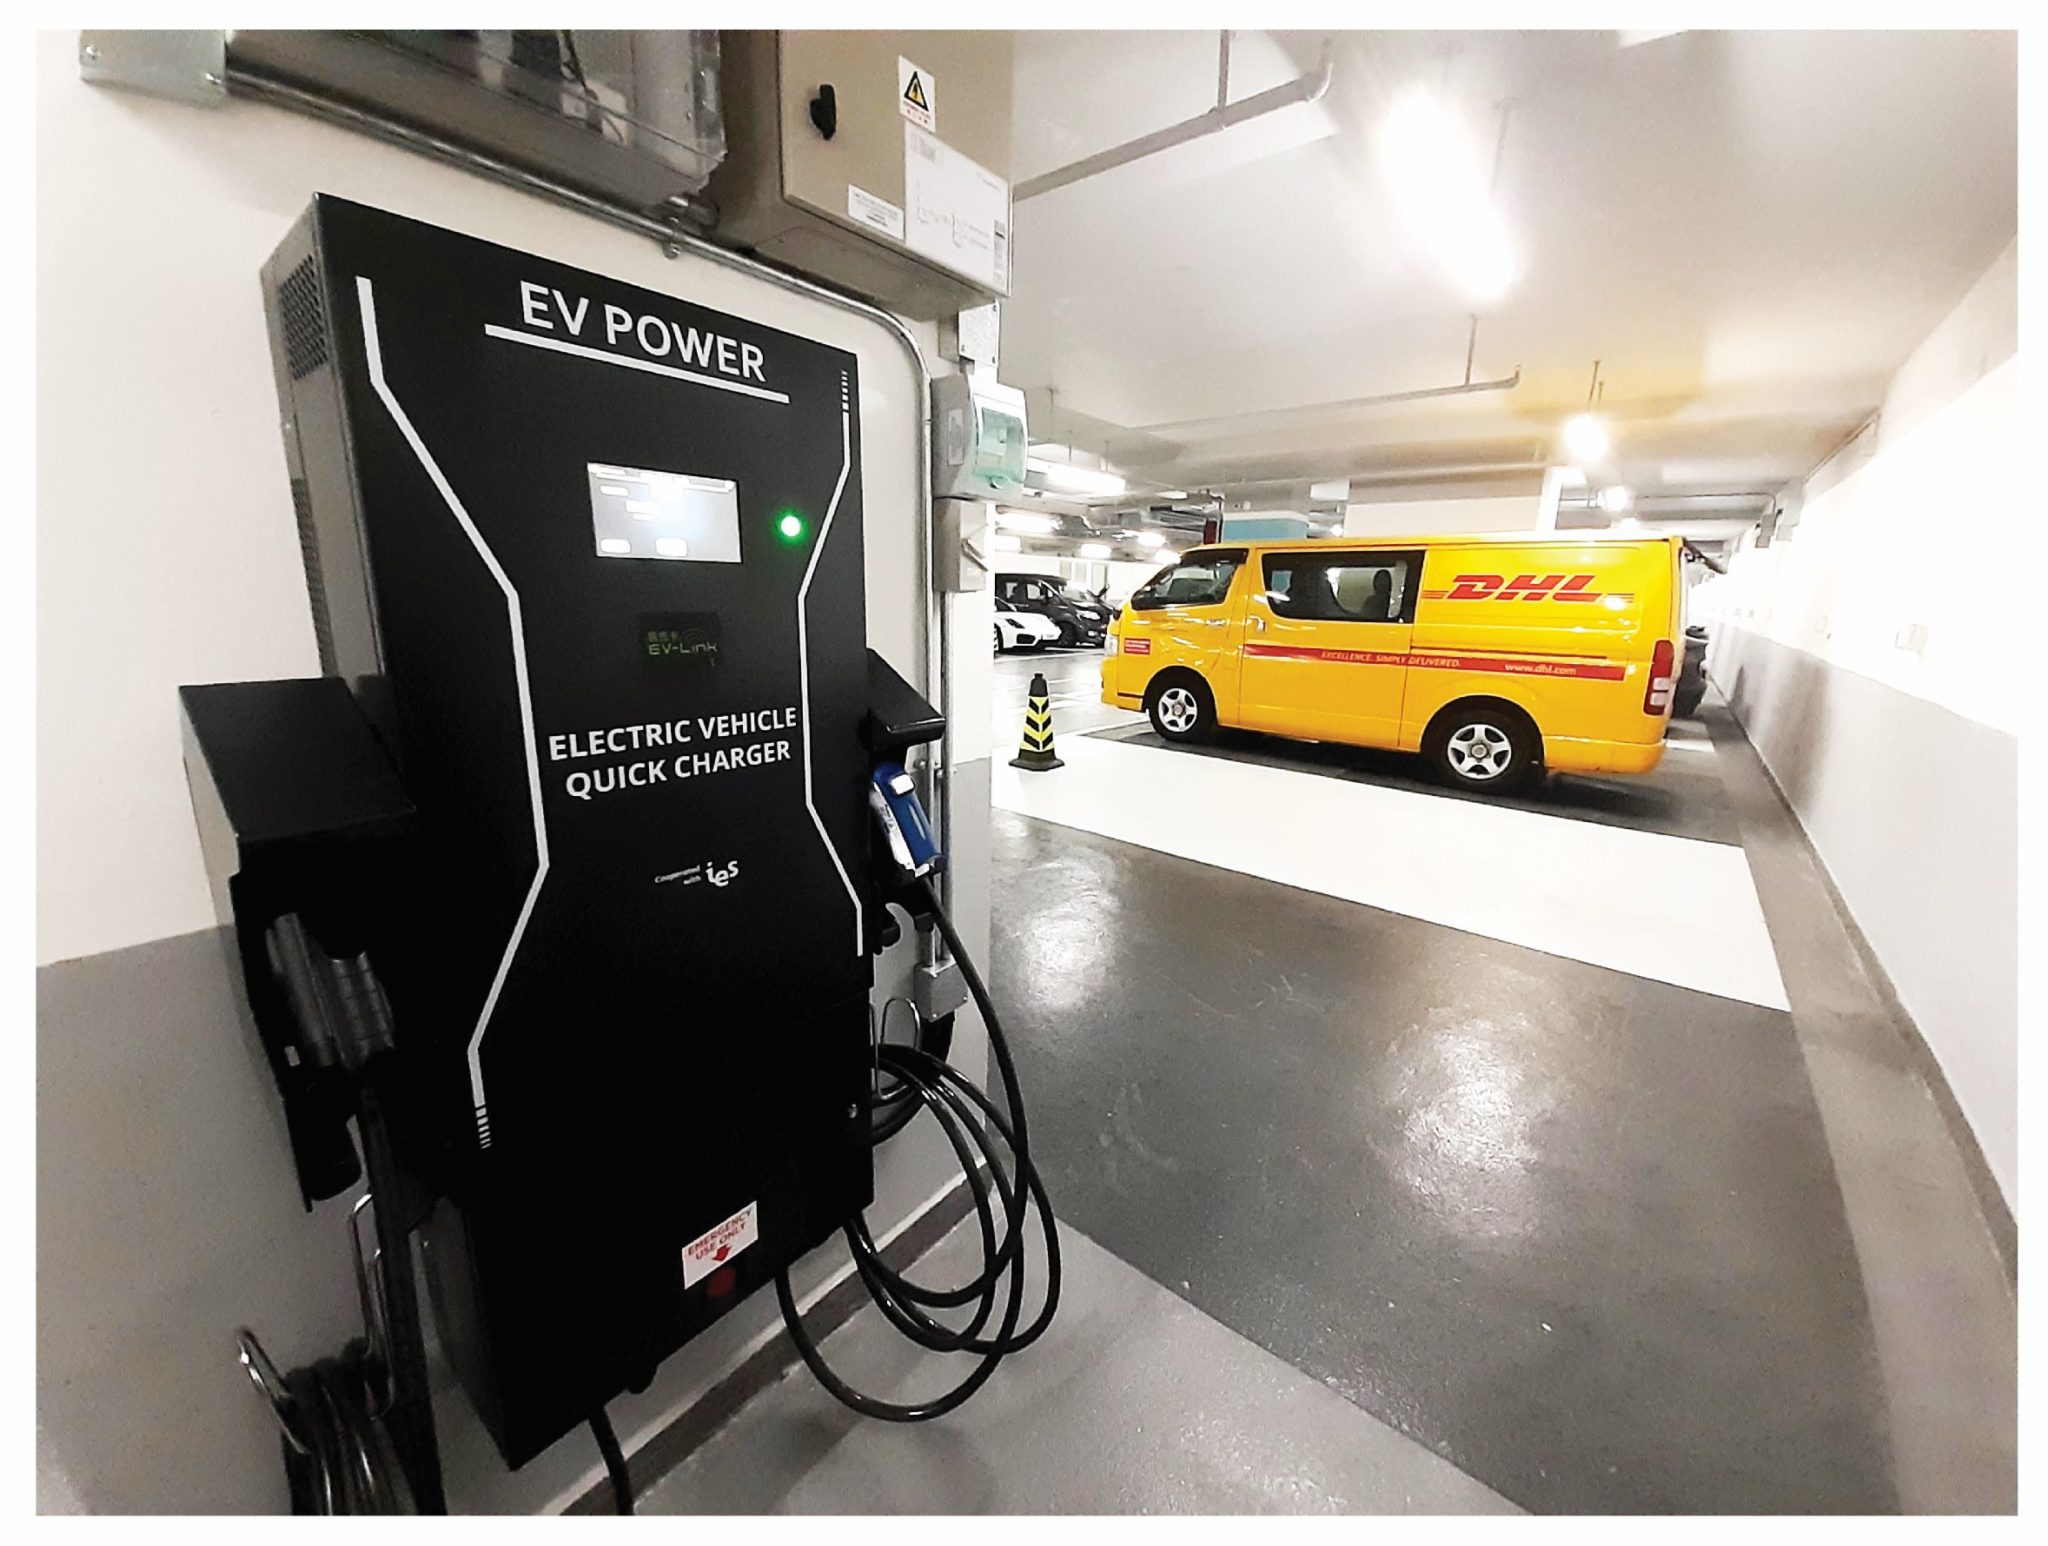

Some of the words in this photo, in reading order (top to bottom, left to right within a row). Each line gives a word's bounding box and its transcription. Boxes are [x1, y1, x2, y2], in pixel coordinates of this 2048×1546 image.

[520, 280, 589, 337] EV
[604, 303, 766, 382] POWER
[1447, 575, 1602, 602] DHL
[648, 641, 718, 656] EV-Link
[1376, 654, 1407, 665] SIMPLY
[1505, 664, 1577, 676] www.dhl.com
[549, 720, 692, 761] ELECTRIC
[698, 707, 797, 740] VEHICLE
[566, 759, 668, 800] QUICK
[674, 740, 791, 778] CHARGER
[706, 860, 739, 887] ies
[688, 1208, 751, 1256] EMERGENCY
[696, 1243, 714, 1260] USE
[719, 1223, 745, 1244] ONLY
